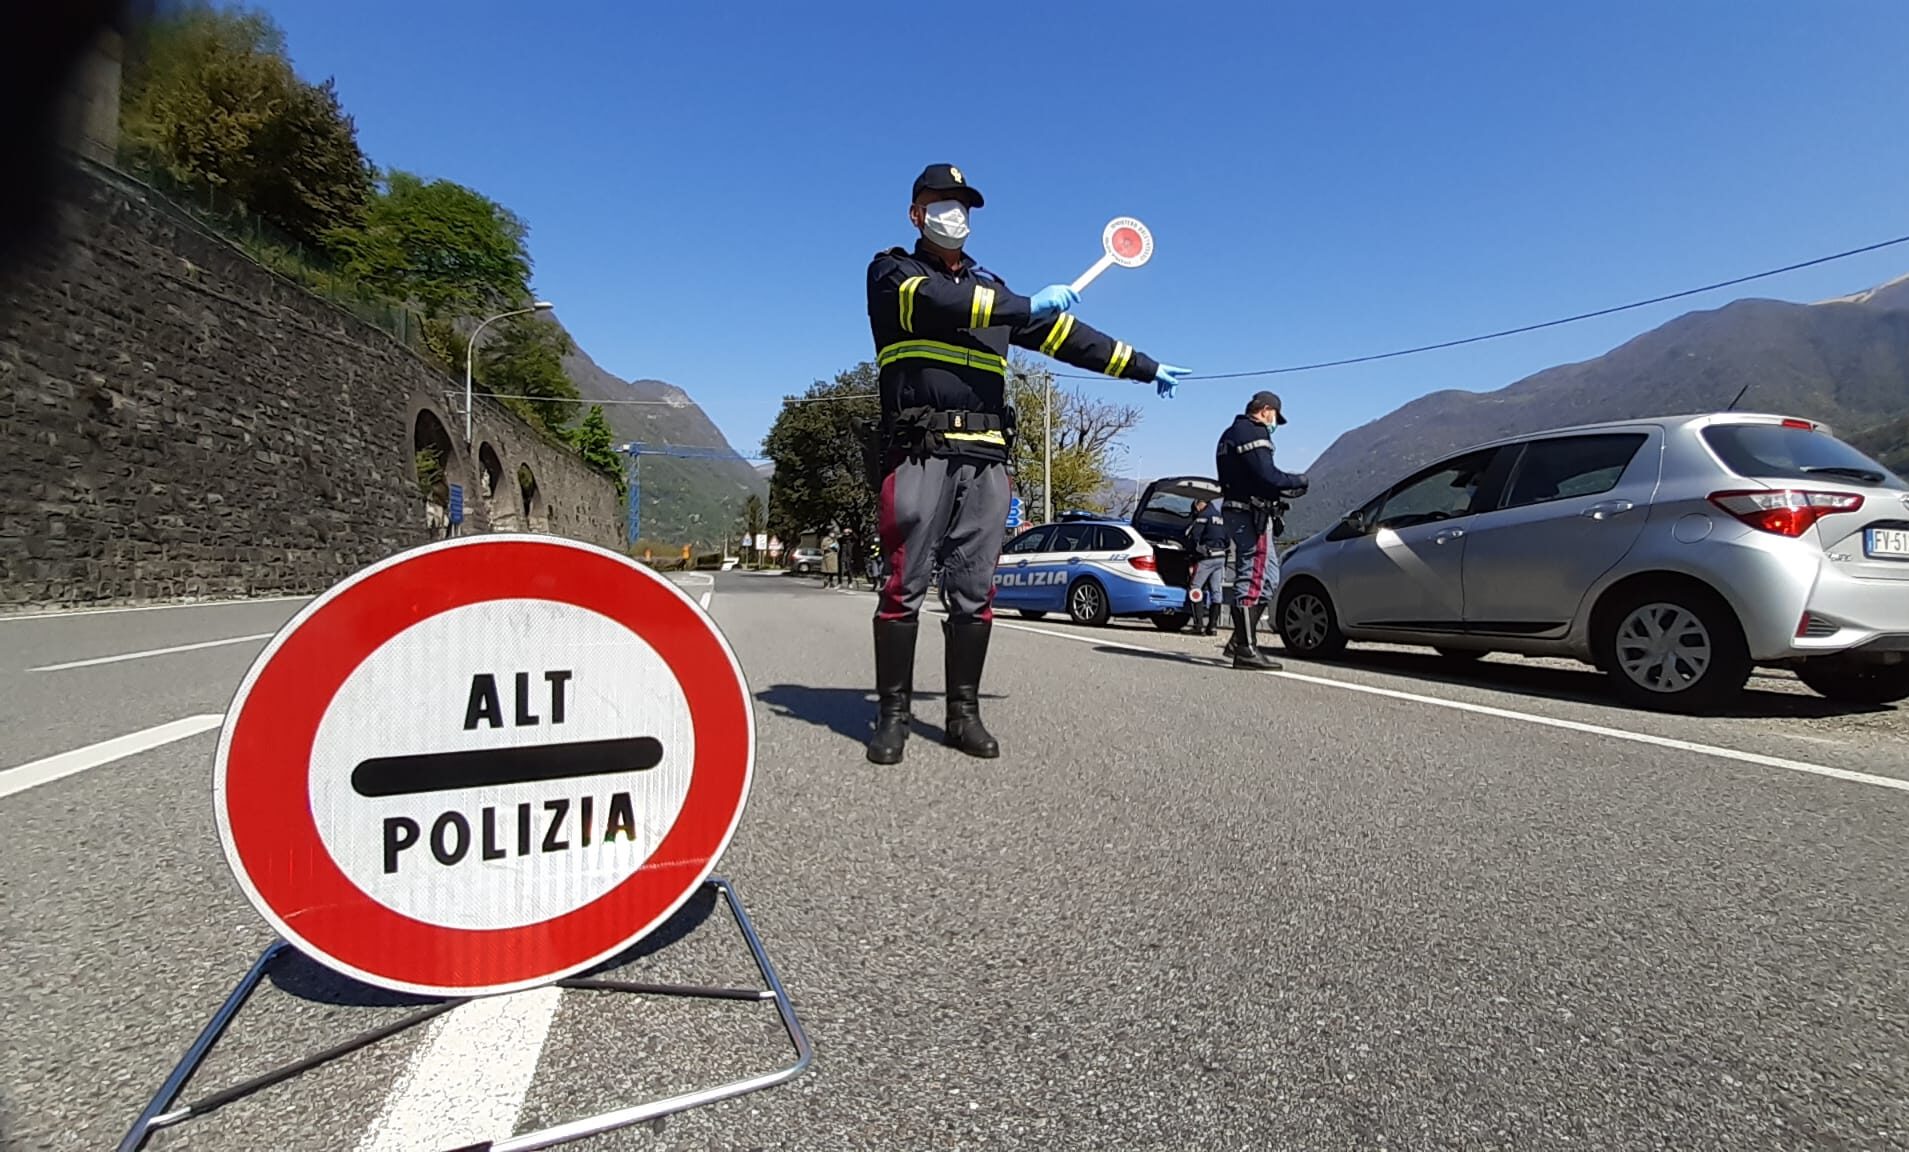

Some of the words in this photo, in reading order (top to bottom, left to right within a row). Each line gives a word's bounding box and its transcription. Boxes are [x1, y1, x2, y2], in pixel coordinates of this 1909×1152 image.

[992, 570, 1068, 587] POLIZIA
[463, 669, 573, 731] ALT
[383, 791, 637, 874] POLIZIA
